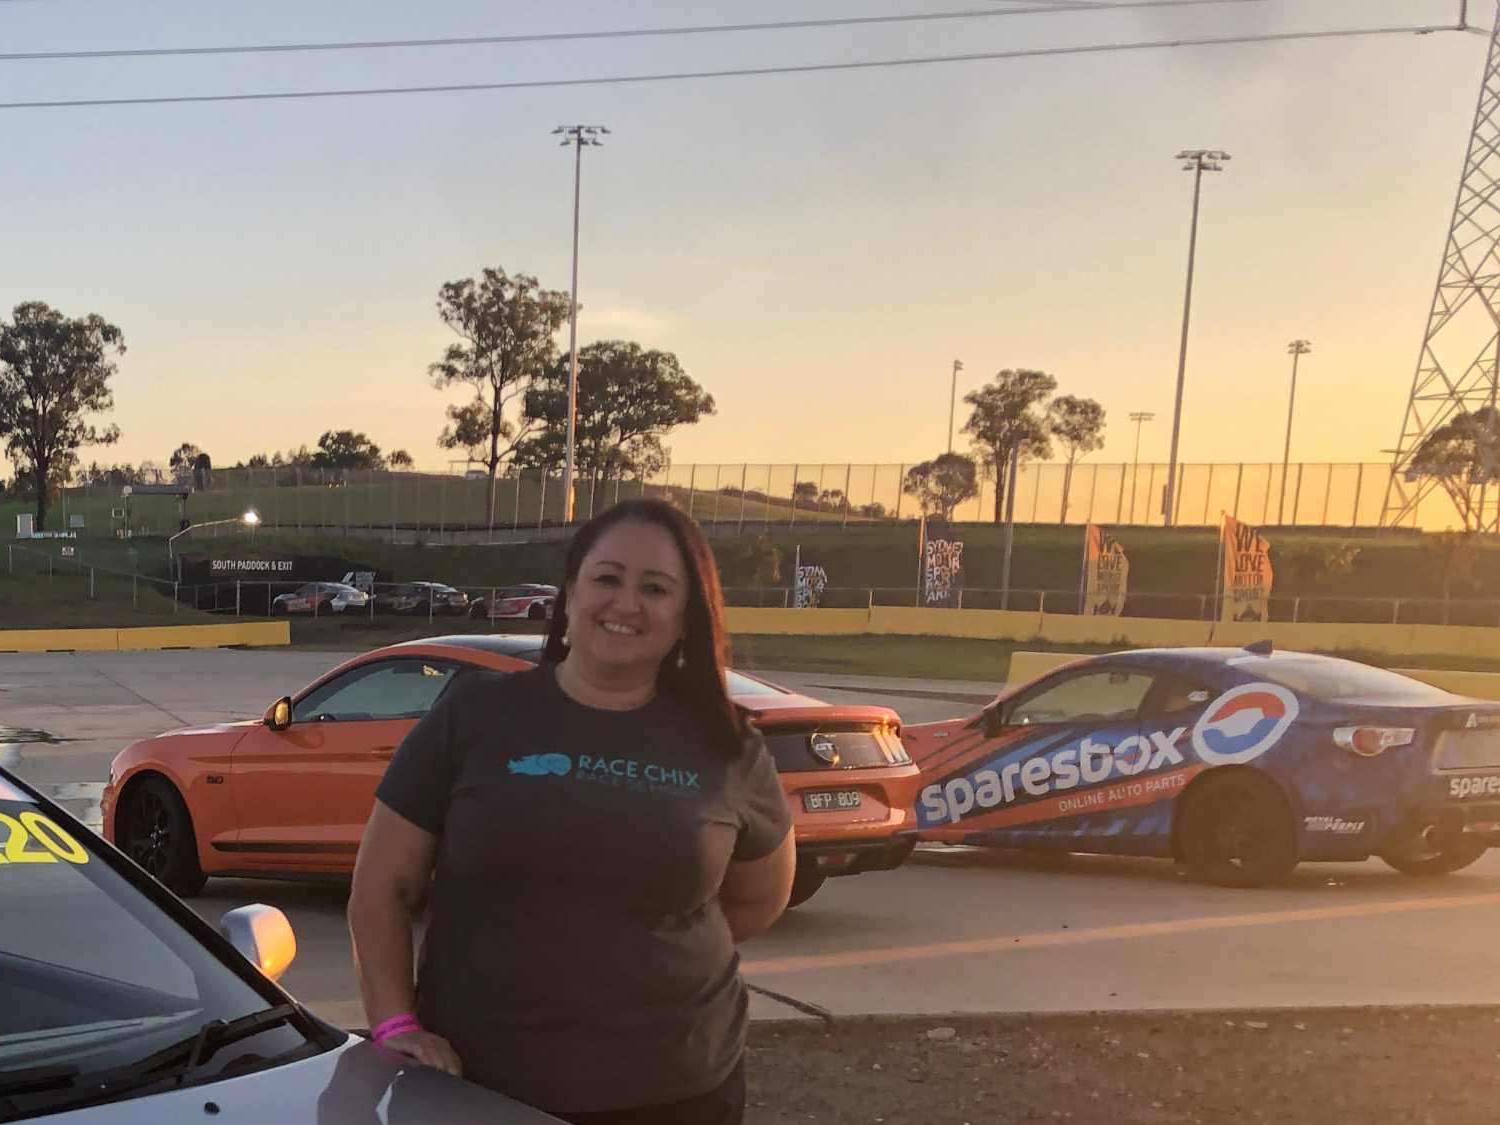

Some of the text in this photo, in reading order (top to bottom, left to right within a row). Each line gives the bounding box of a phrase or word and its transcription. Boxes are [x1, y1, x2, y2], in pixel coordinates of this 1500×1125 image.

[212, 560, 236, 570] SOUTH
[237, 560, 270, 571] PADDOCK
[278, 561, 293, 571] EXIT
[1235, 554, 1264, 573] LOVE
[578, 754, 639, 778] RACE
[643, 764, 700, 787] CHIX
[921, 727, 1188, 824] sparesbox
[1058, 773, 1187, 812] ONLINE AUTO PARTS
[1449, 775, 1500, 799] spare
